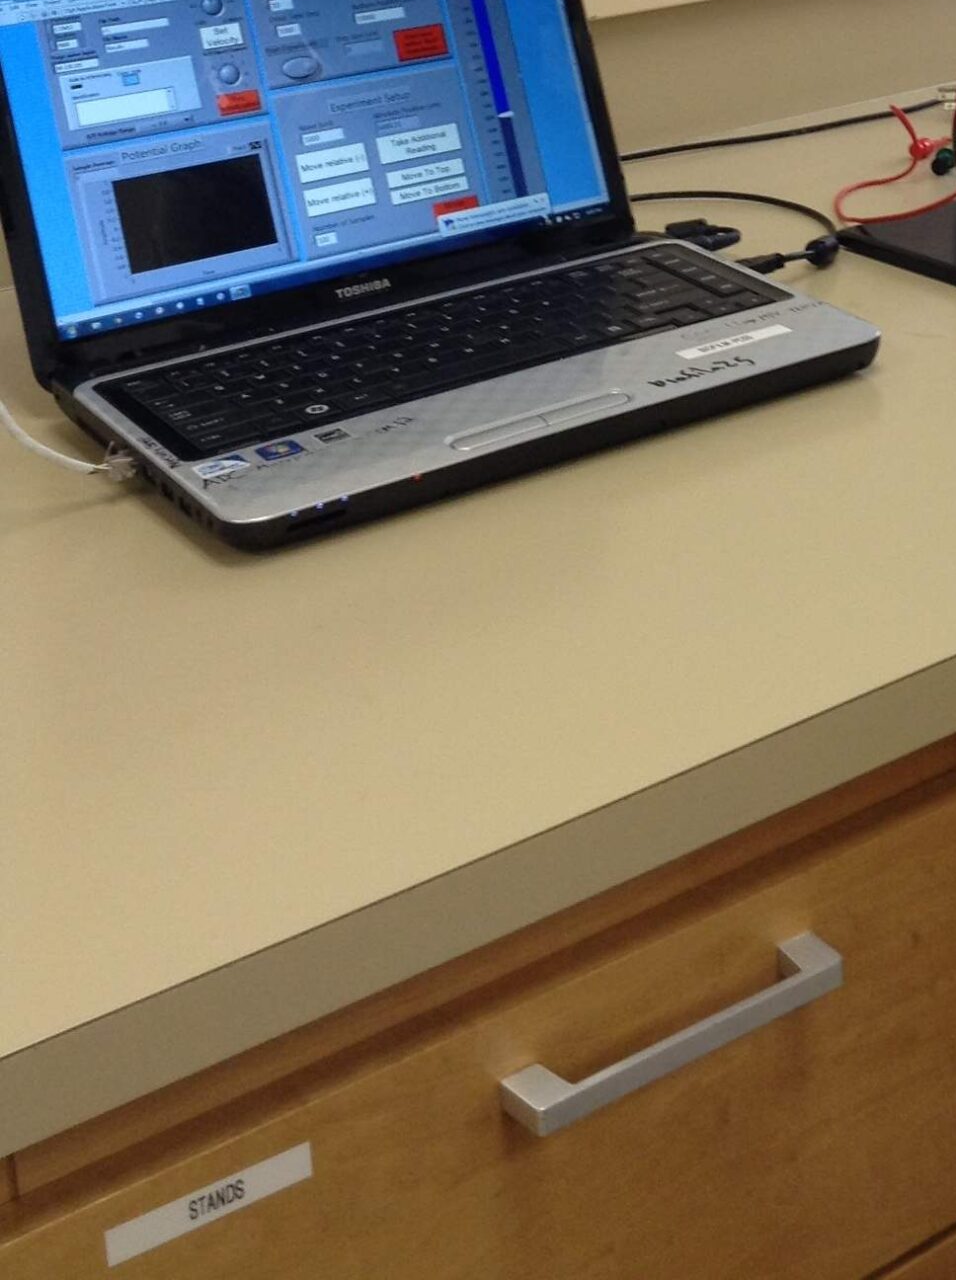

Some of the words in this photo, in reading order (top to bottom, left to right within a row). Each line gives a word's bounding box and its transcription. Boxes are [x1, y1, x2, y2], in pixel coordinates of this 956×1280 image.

[206, 35, 240, 50] Velocity
[329, 95, 381, 114] Experiment
[121, 146, 169, 162] Potential
[170, 138, 203, 155] Graph
[300, 160, 324, 173] Move
[324, 156, 355, 169] relative
[306, 195, 330, 208] Move
[330, 190, 361, 203] relative
[334, 278, 391, 299] TOSHIBA
[188, 1178, 245, 1220] STANDS
